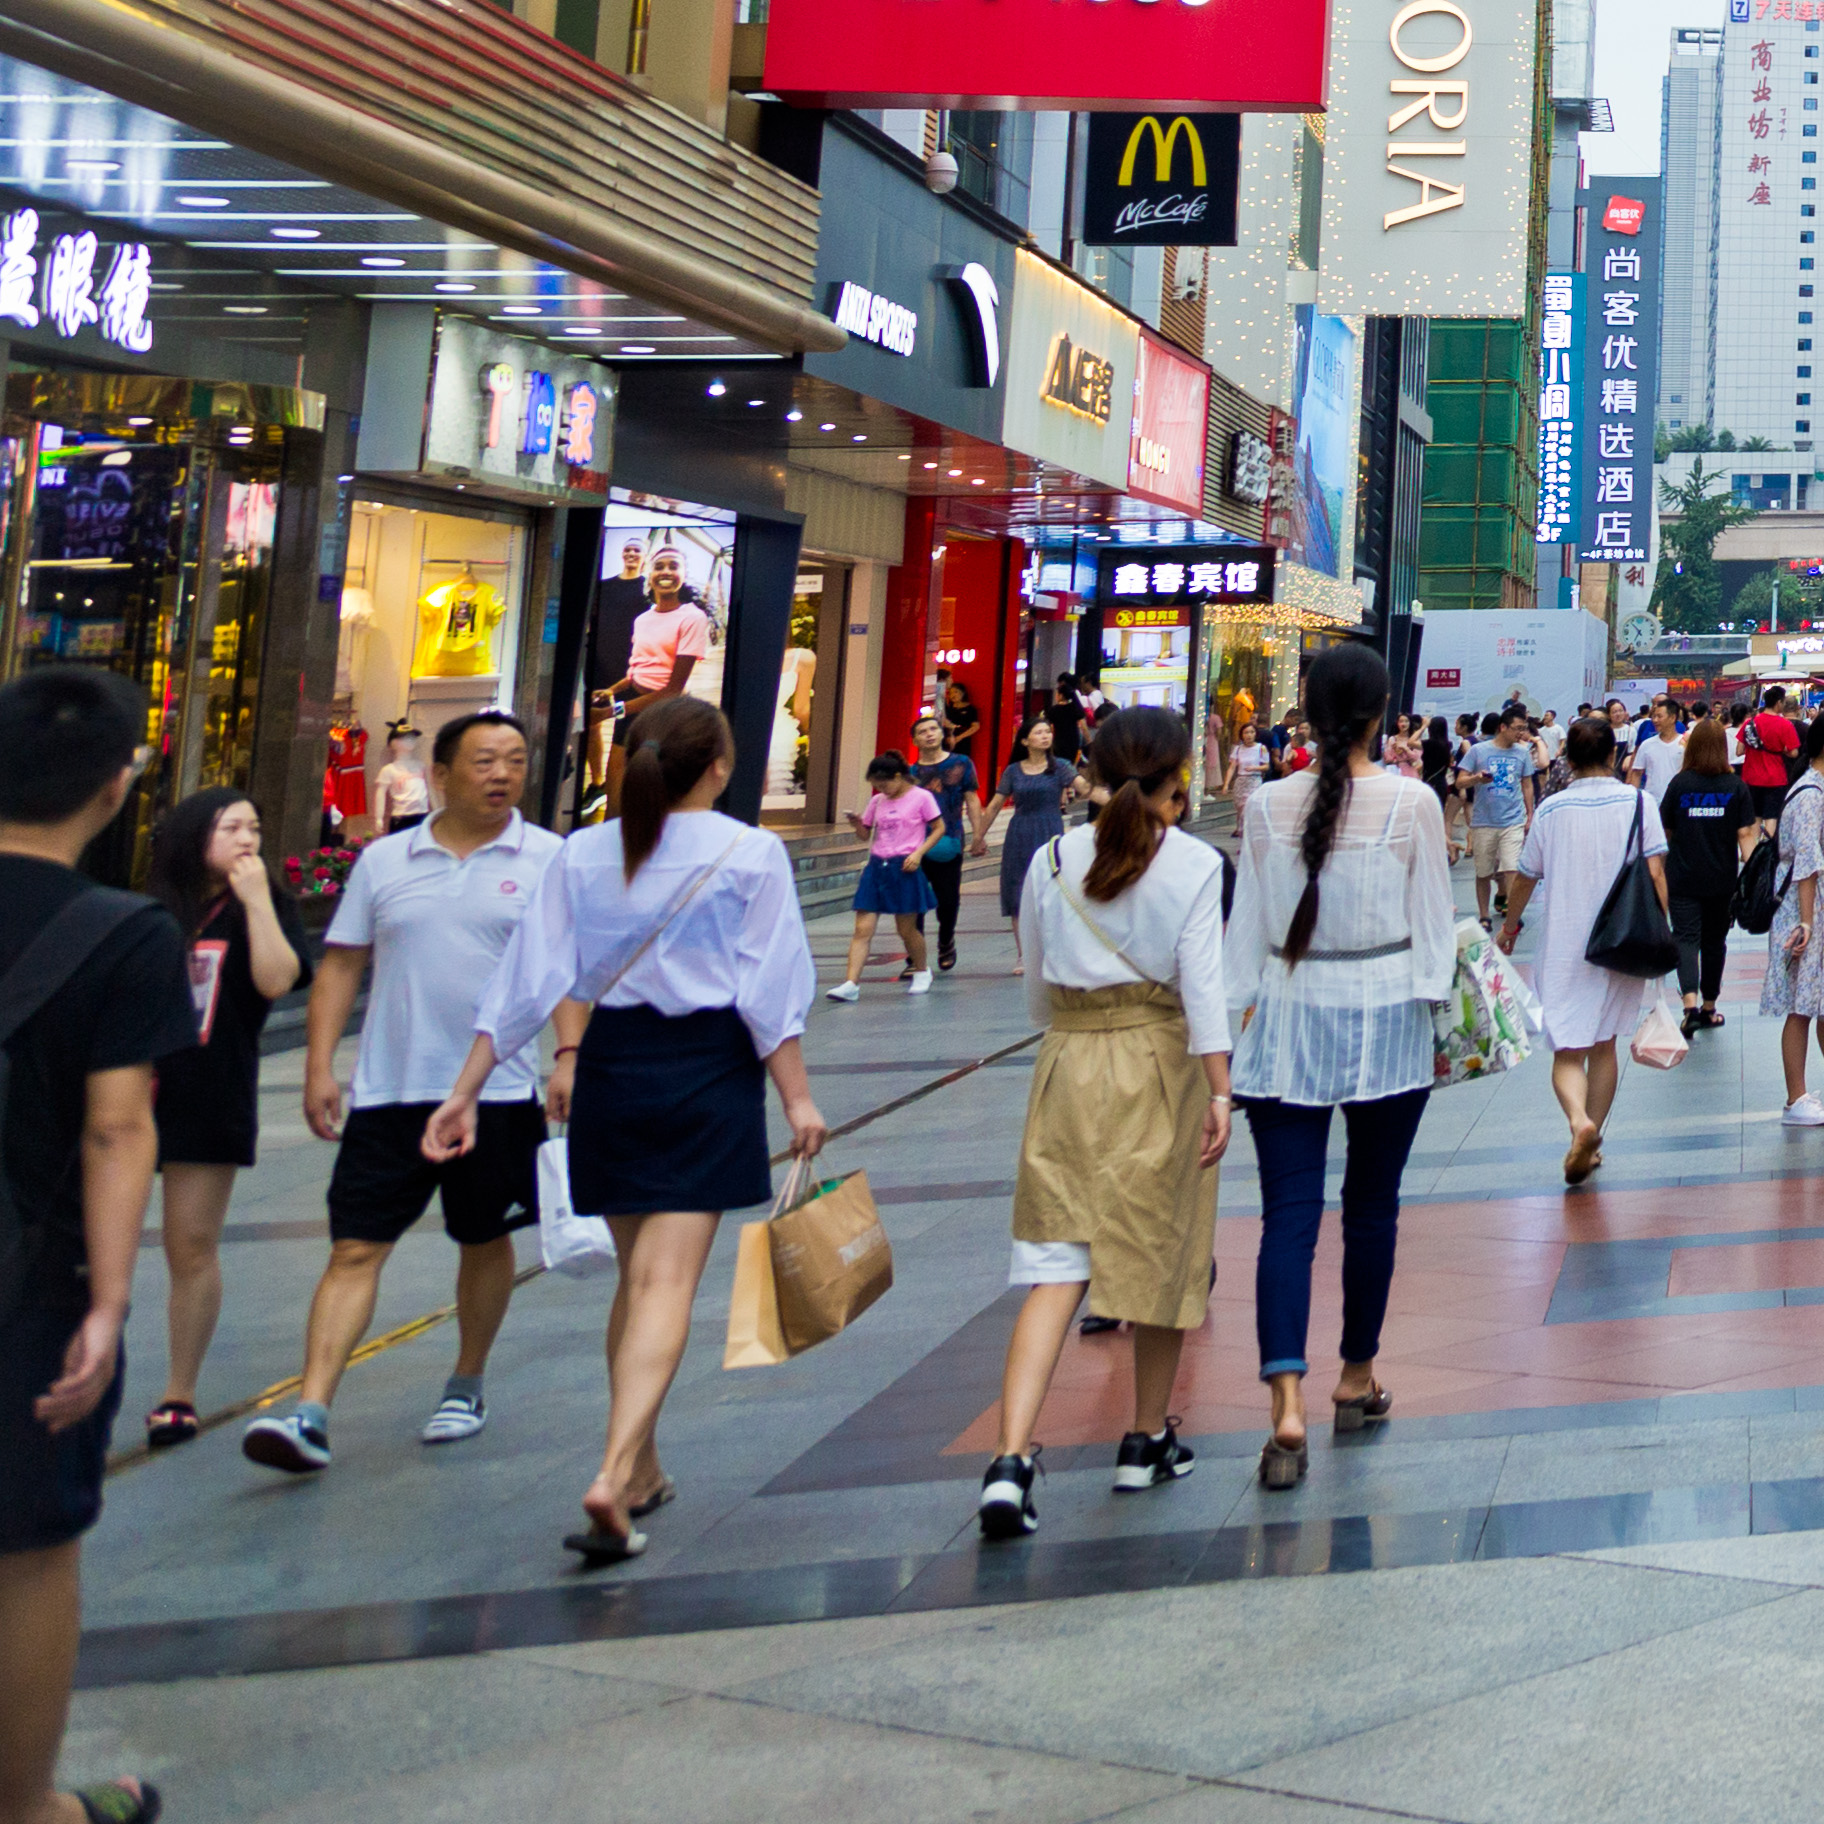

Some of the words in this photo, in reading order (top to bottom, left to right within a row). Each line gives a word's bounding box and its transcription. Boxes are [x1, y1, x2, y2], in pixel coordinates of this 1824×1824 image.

[1116, 193, 1208, 232] McCafé
[868, 296, 917, 357] SPORTS
[1595, 246, 1641, 547] 尚客优精选酒店
[1114, 562, 1260, 595] 鑫春宾馆
